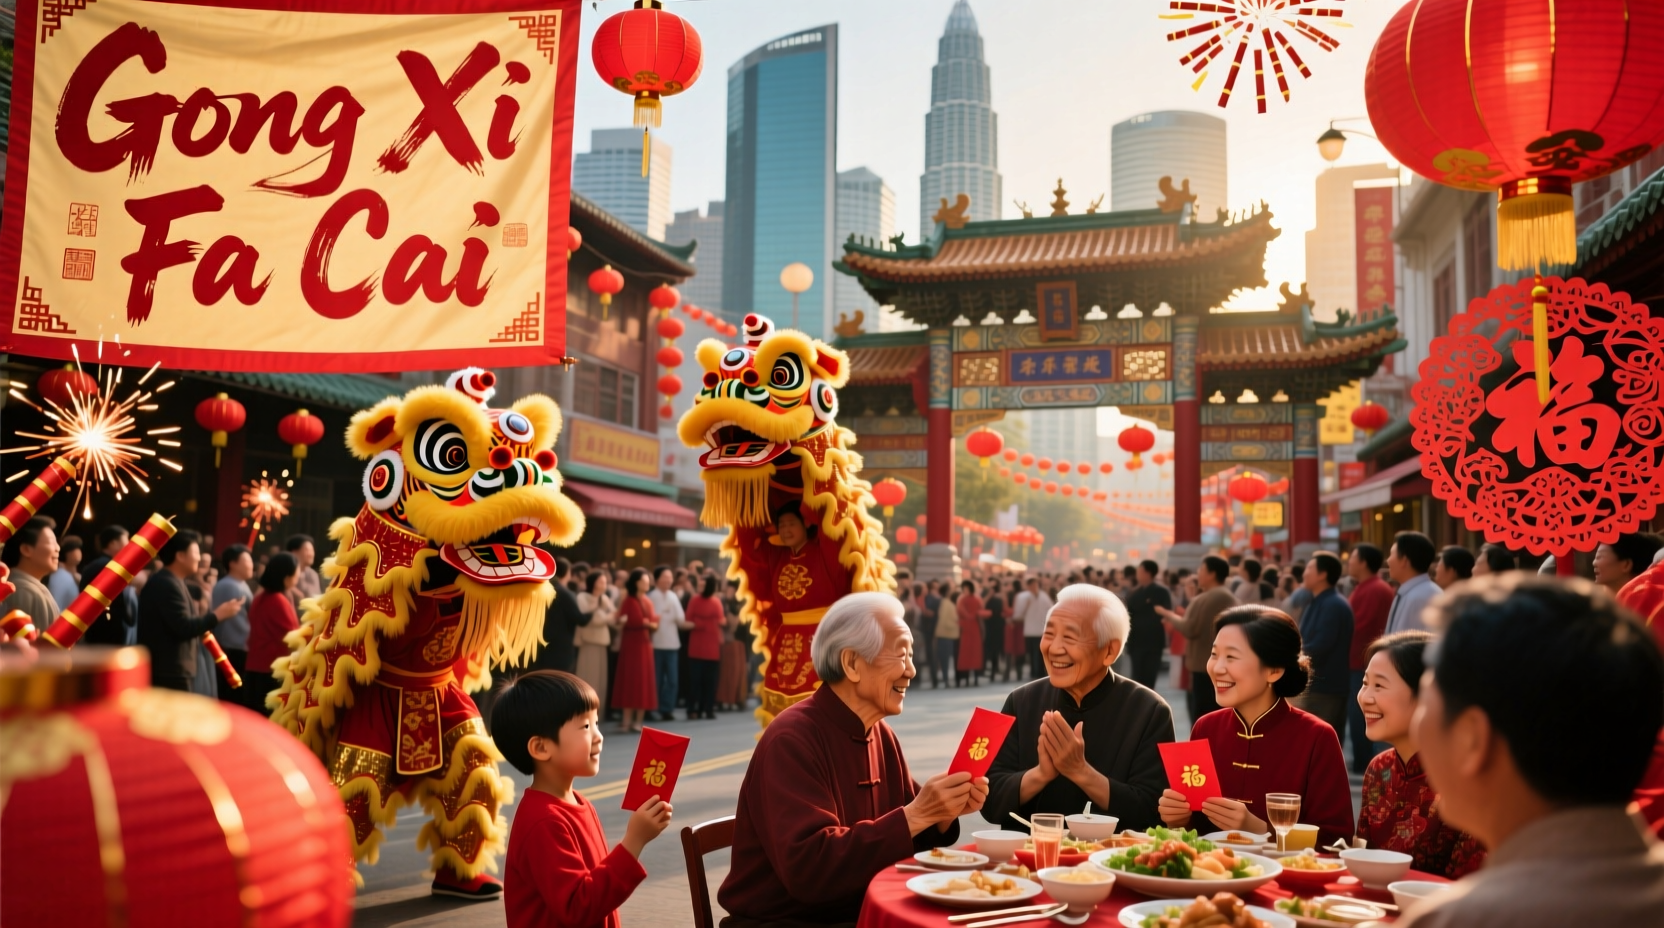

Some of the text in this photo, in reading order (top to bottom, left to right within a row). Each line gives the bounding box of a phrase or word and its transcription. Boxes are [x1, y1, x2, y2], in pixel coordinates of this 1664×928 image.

[54, 21, 531, 198] Gong Xi
[121, 184, 500, 328] Fa Cai
[1485, 335, 1622, 469] 福
[968, 736, 989, 761] 福
[1180, 764, 1206, 788] 福
